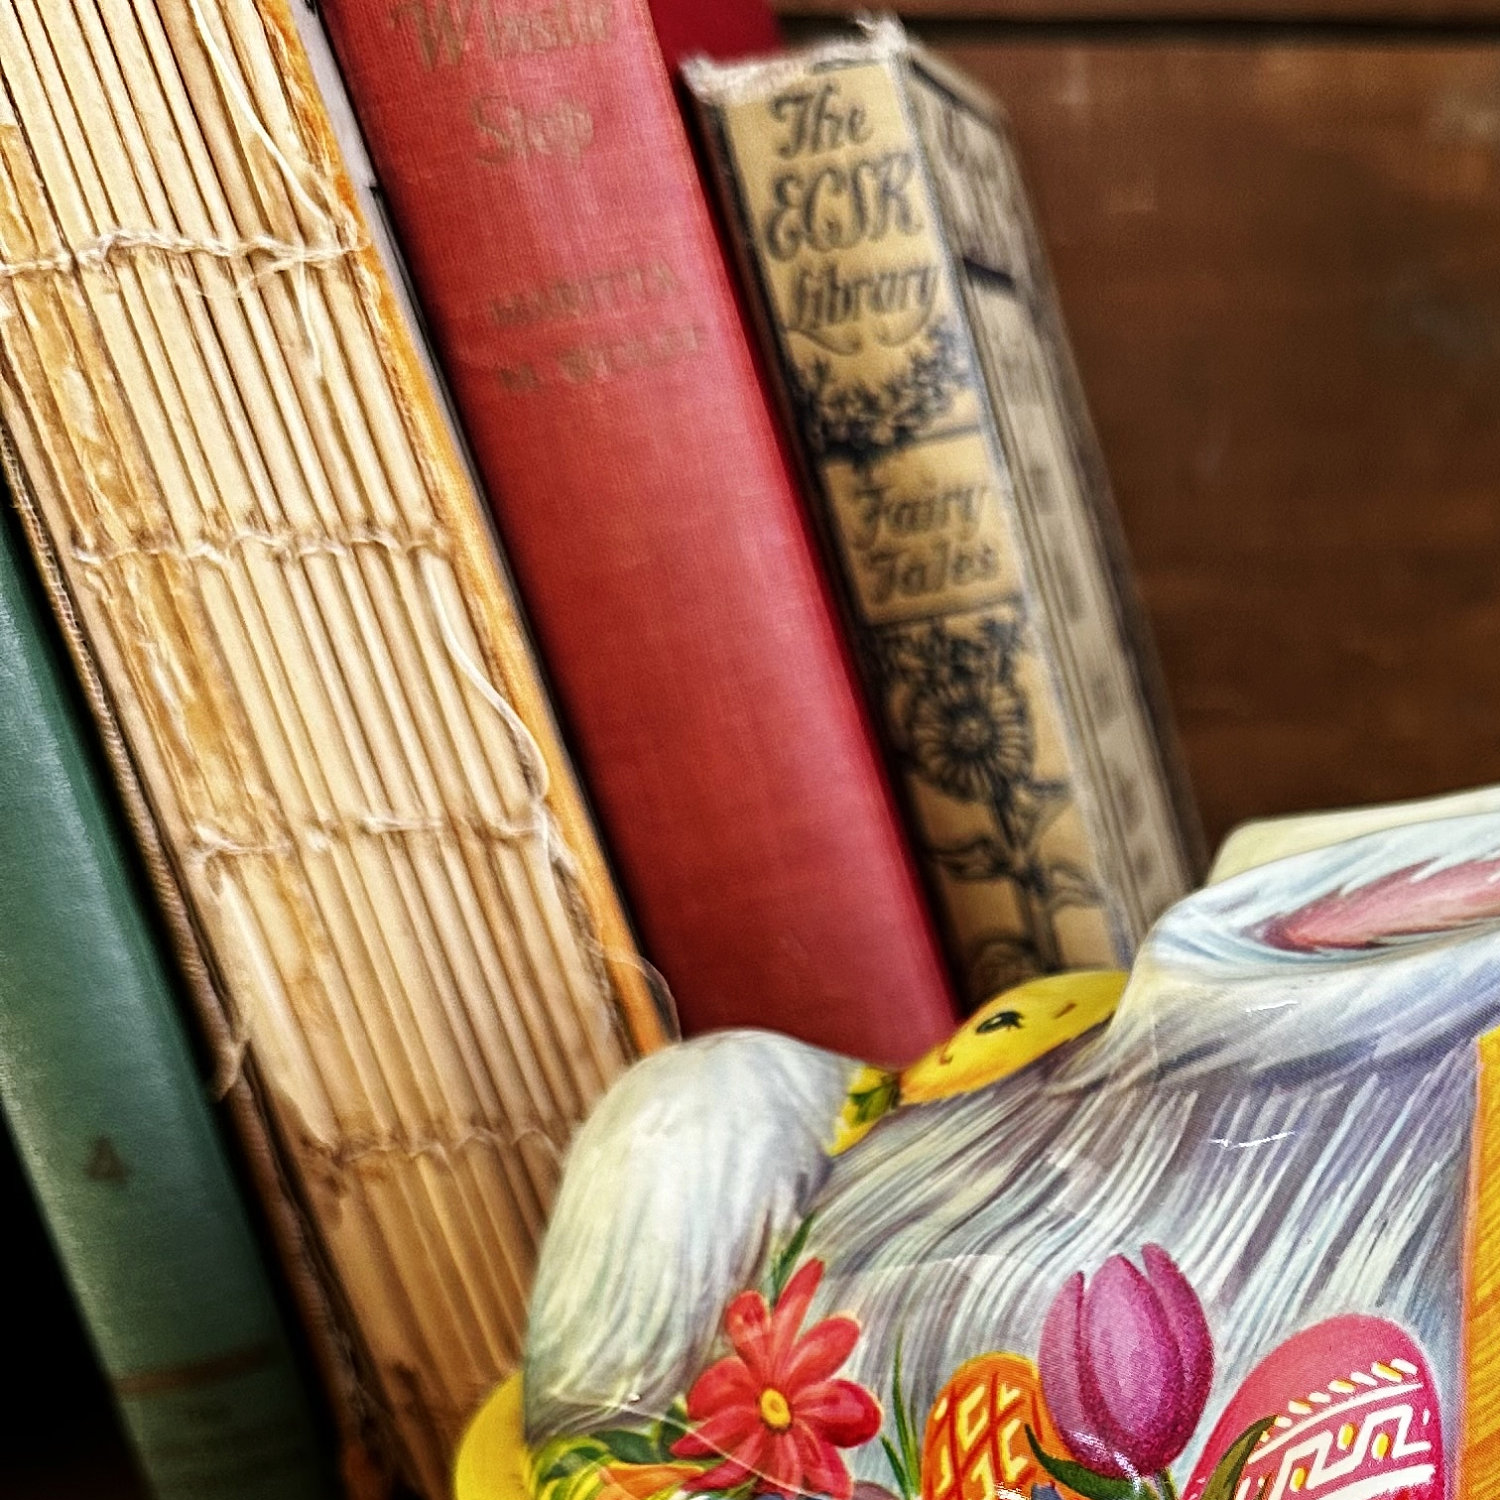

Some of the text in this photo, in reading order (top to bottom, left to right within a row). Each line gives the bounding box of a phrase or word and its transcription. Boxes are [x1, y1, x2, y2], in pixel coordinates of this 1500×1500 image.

[768, 82, 874, 160] The
[785, 260, 943, 357] Library
[852, 478, 990, 550] Fairy
[866, 540, 1002, 607] Tales
